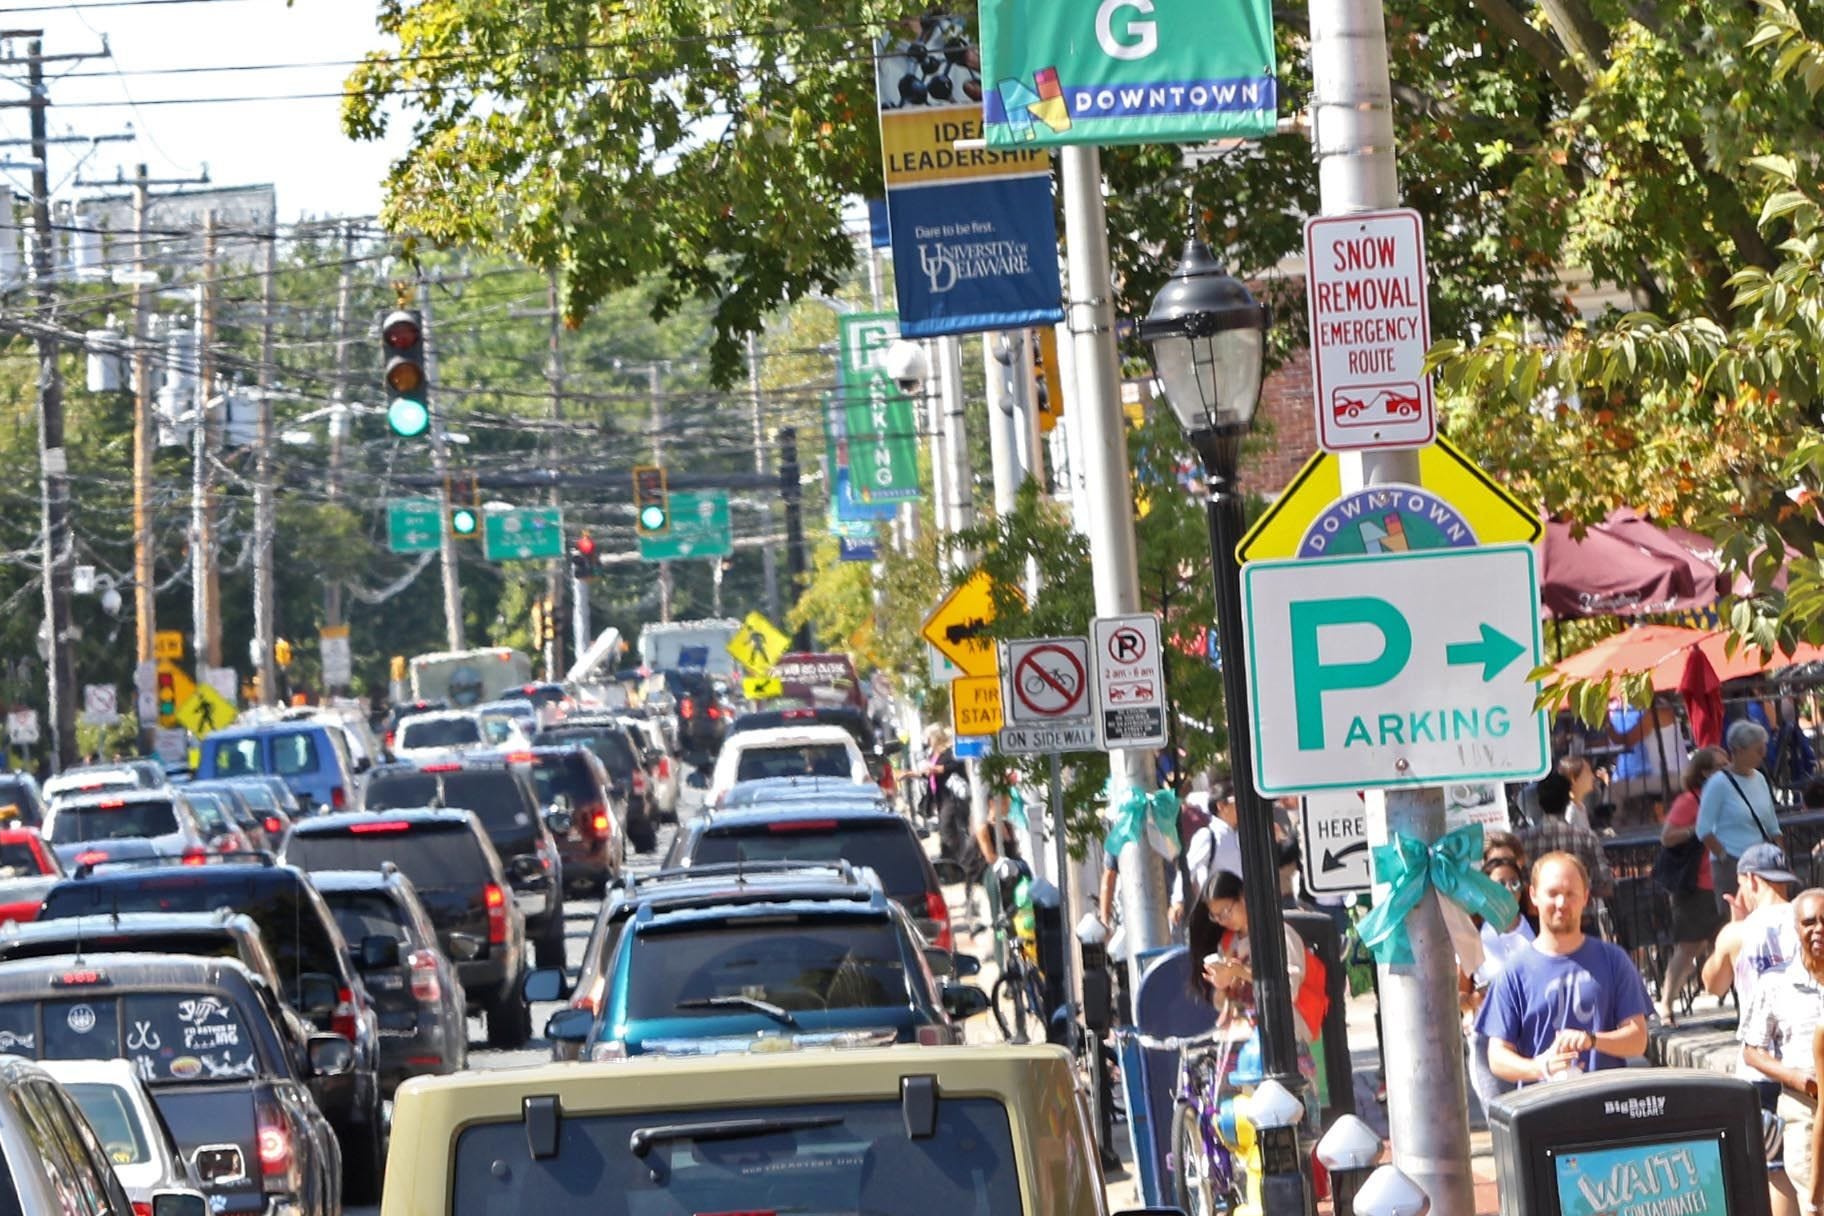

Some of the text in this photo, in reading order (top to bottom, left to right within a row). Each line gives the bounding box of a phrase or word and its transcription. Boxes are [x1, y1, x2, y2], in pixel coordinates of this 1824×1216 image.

[1095, 0, 1158, 60] G
[1076, 84, 1259, 111] DOWNTOWN
[889, 147, 1042, 173] LEADERSHIP
[915, 221, 996, 239] Dare to be first.
[917, 240, 1014, 277] UNIVERSITY
[1333, 236, 1396, 272] SNOW
[926, 254, 1031, 293] DELAWARE
[1318, 277, 1418, 313] REMOVAL
[1320, 316, 1418, 347] EMERGENCY
[1348, 348, 1396, 374] ROUTE
[1309, 491, 1466, 551] DOWNTOWN
[1289, 595, 1511, 751] PARKING
[974, 688, 999, 703] FIR
[961, 708, 1002, 724] STAT
[1007, 729, 1026, 747] ON
[1318, 817, 1365, 839] HERE
[1604, 1096, 1665, 1115] BigBelly
[1578, 1148, 1699, 1211] WAIT!
